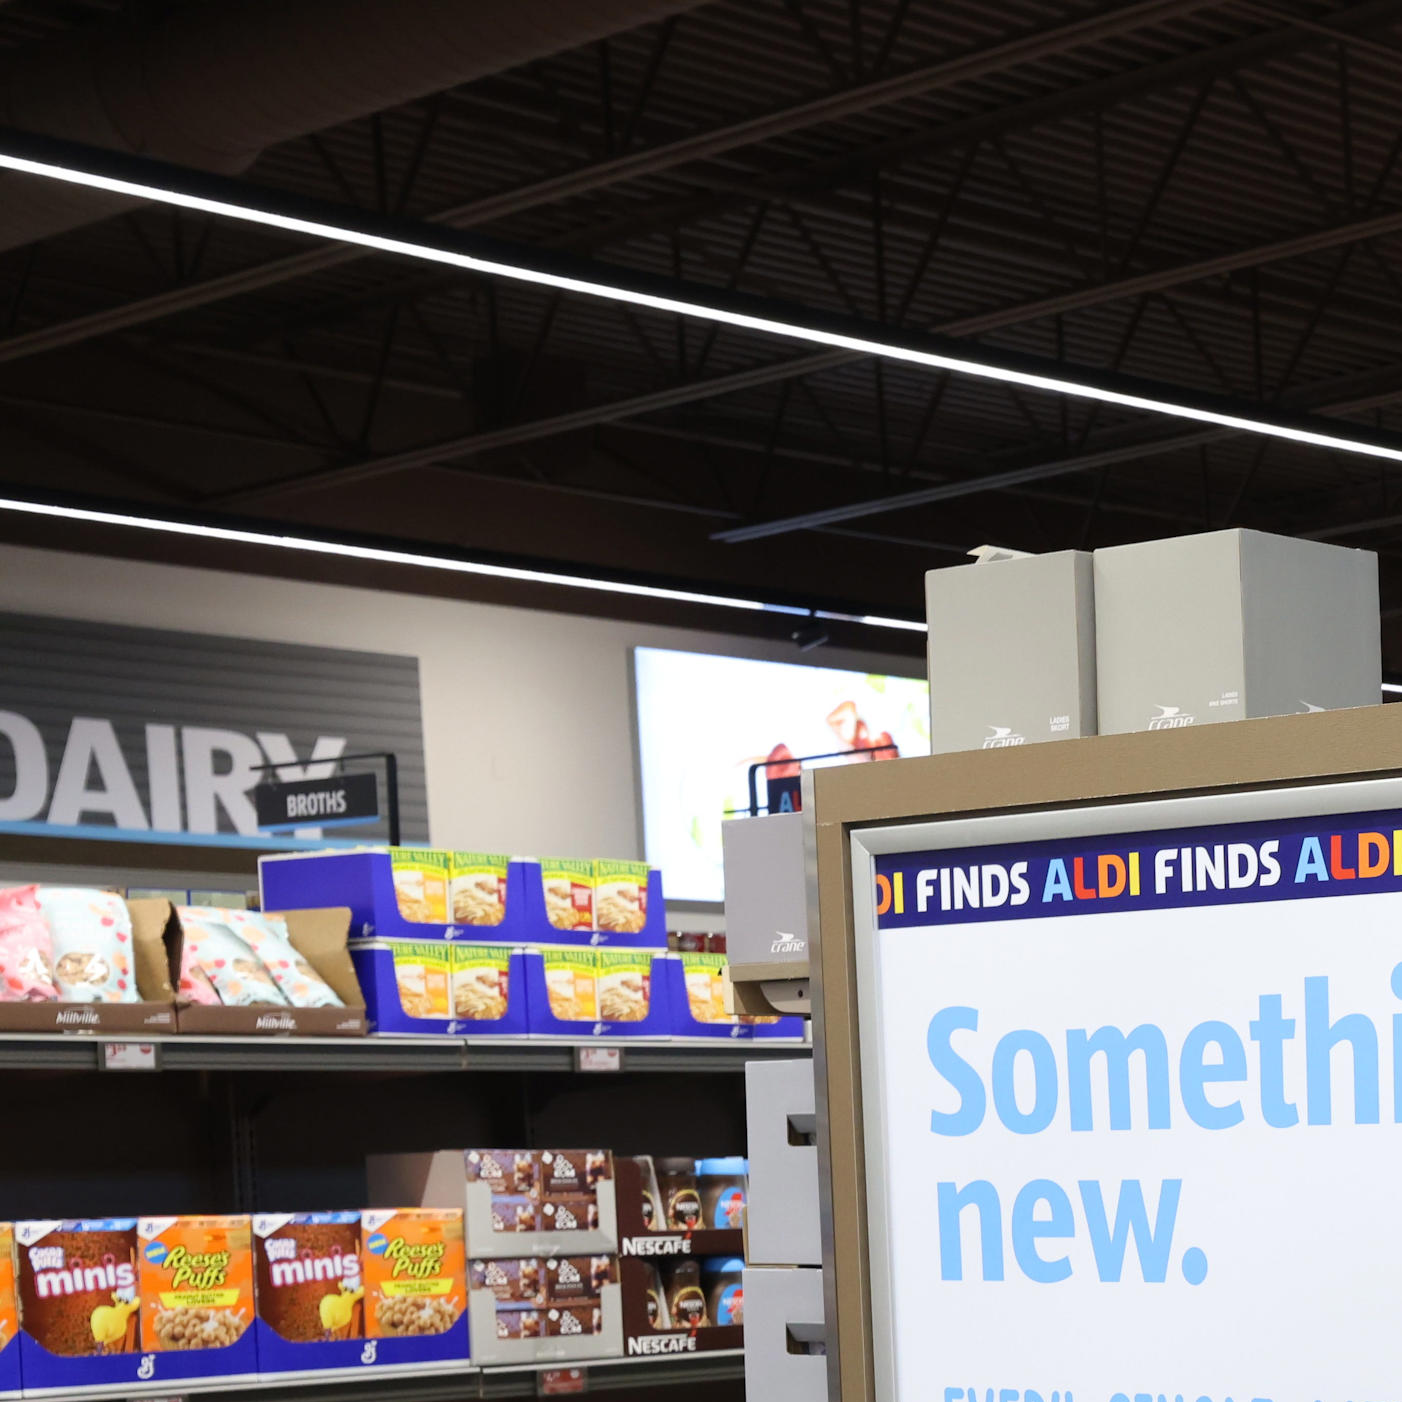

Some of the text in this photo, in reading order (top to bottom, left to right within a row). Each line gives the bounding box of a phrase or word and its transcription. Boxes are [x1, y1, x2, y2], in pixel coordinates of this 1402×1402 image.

[287, 790, 347, 817] BROTHS
[916, 861, 1030, 913] FINDS
[1042, 853, 1141, 902] ALDI
[1155, 840, 1281, 896] FINDS
[771, 941, 805, 953] crane
[936, 1178, 1208, 1285] new.
[163, 1245, 230, 1269] Reese's
[385, 1238, 445, 1262] Reese's
[36, 1254, 135, 1297] minis
[172, 1267, 226, 1290] Puffs
[272, 1245, 360, 1287] minis
[393, 1256, 441, 1279] Puffs
